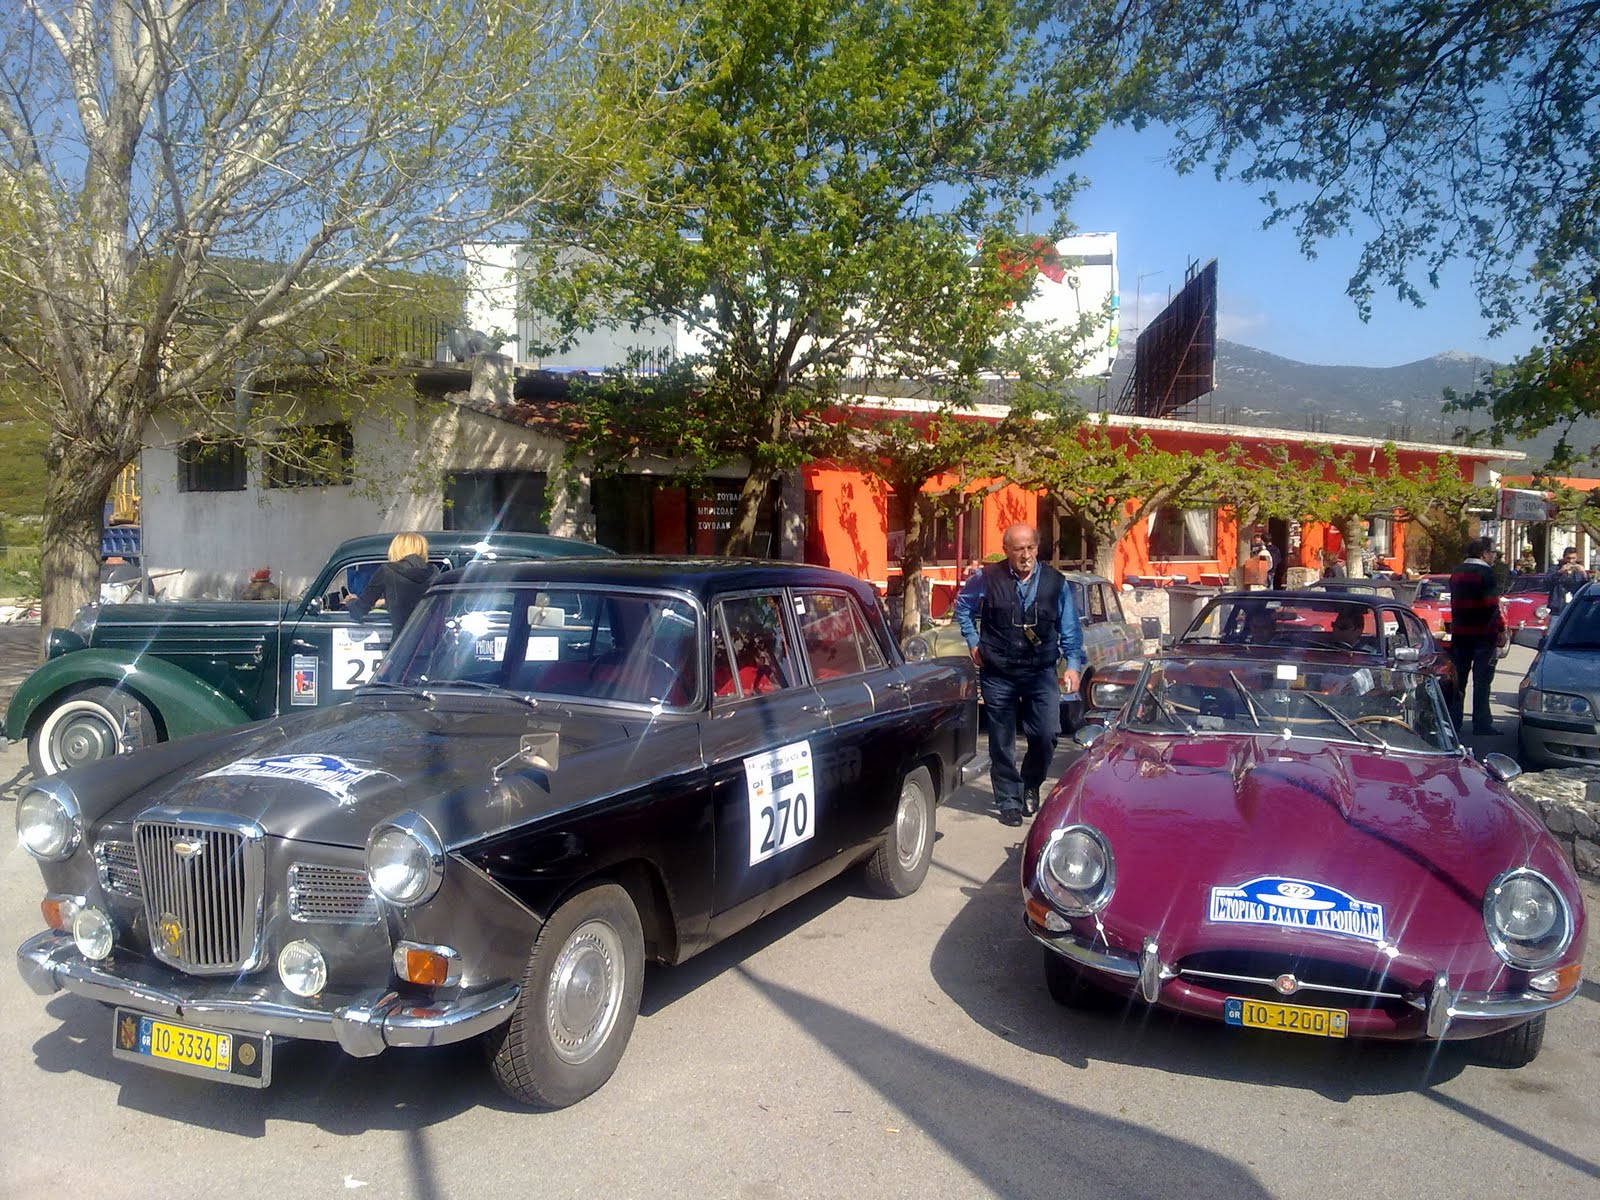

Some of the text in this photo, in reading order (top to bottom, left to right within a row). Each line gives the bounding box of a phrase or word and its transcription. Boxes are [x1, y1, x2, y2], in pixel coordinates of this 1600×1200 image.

[698, 507, 735, 515] ΜΠΡΙΖΟΛΕ
[760, 792, 808, 854] 270
[1282, 883, 1311, 896] 272
[1215, 896, 1381, 938] ΙΣΤΟΡΙΚΟ ΡΑΛΛΥ ΑΚΡΟΠΟΛΙΣ
[1228, 1010, 1241, 1019] GR
[141, 1035, 151, 1046] GR
